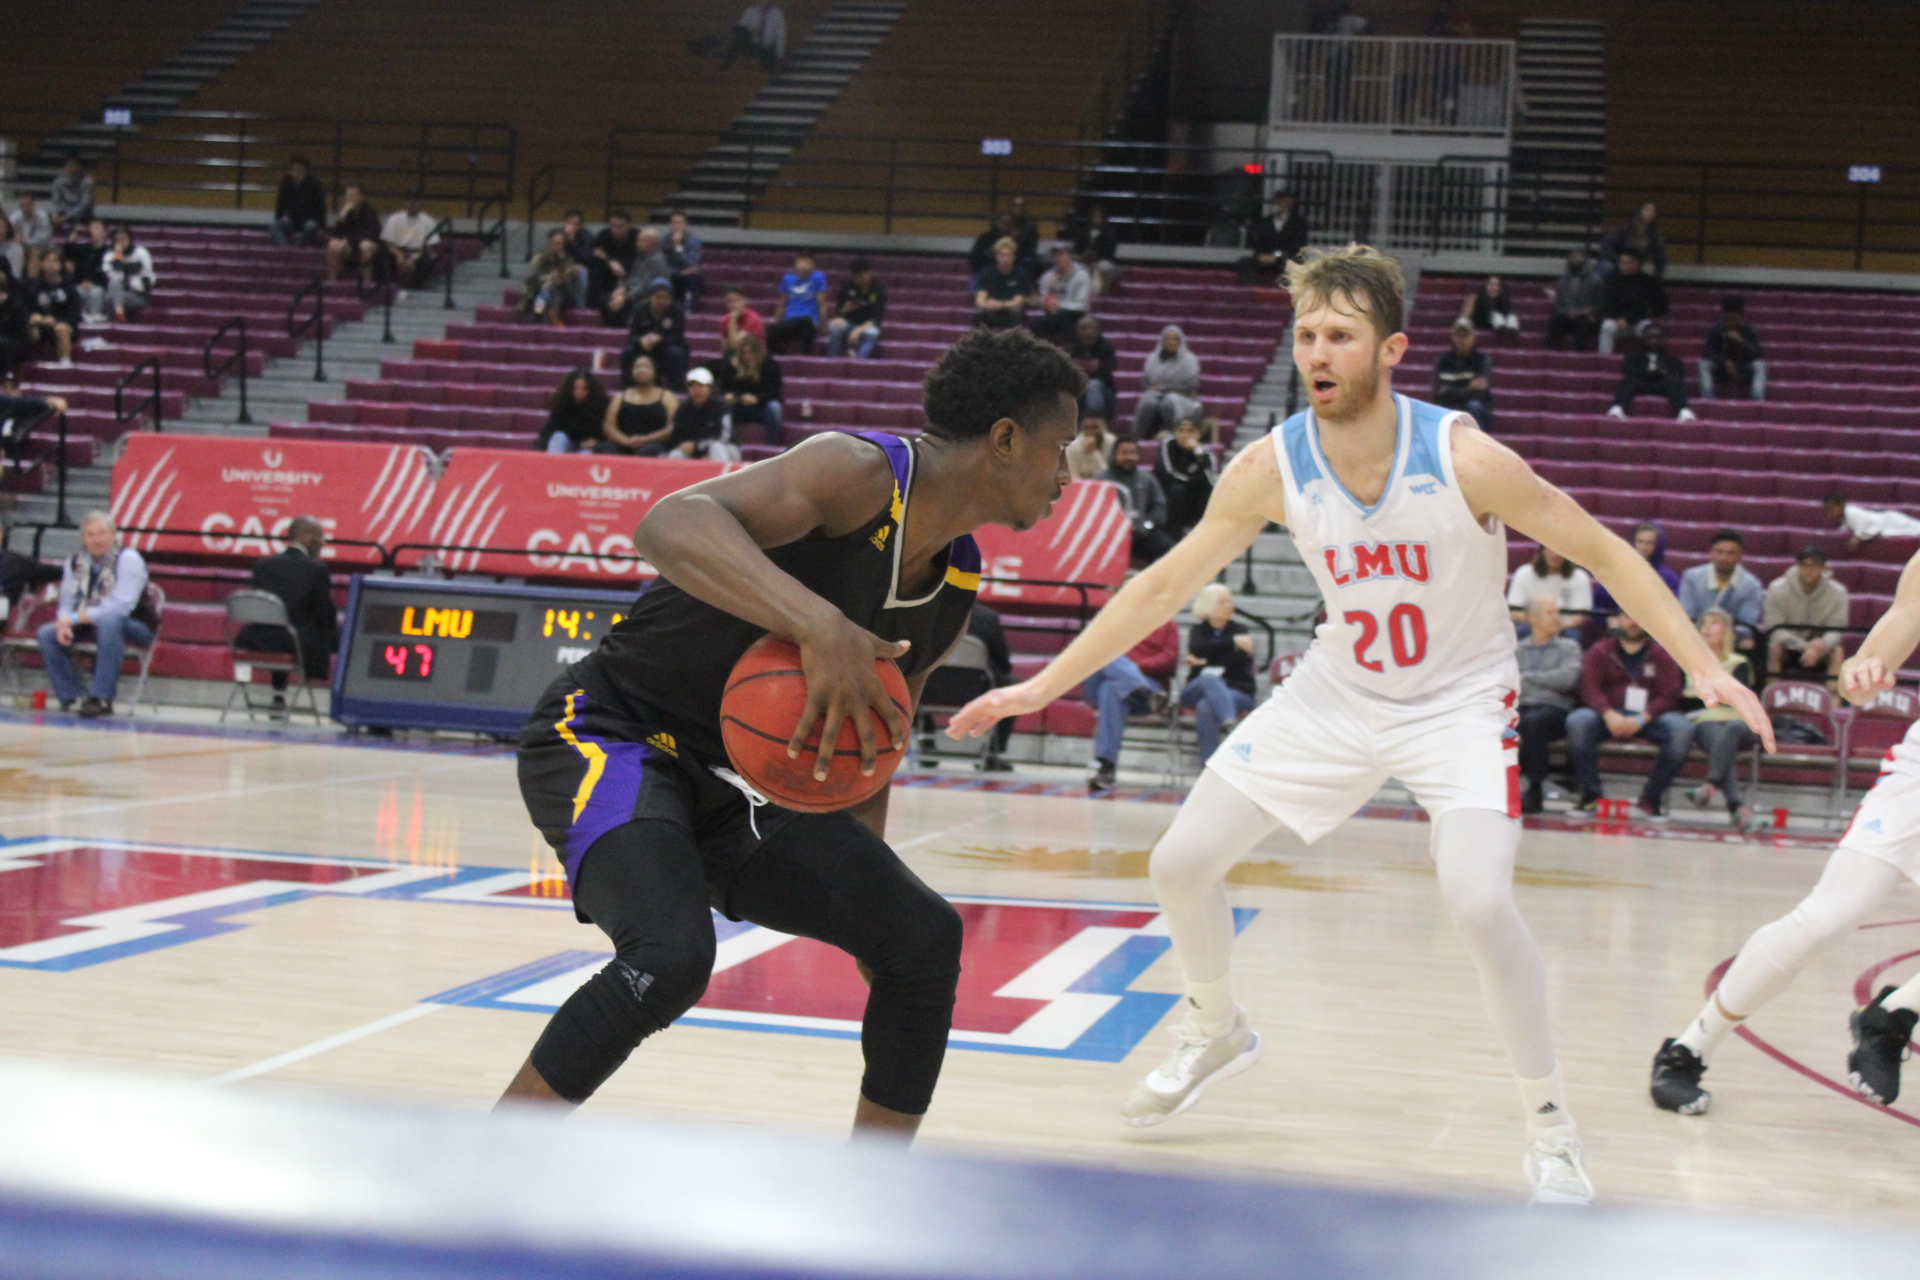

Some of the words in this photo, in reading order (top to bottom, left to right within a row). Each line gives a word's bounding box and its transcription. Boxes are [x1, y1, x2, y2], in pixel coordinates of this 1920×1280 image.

[221, 468, 324, 486] UNIVERSITY
[546, 482, 653, 502] UNIVERSITY
[1323, 541, 1433, 587] LMU
[401, 606, 475, 639] LMU
[1342, 602, 1429, 673] 20
[384, 644, 433, 677] 47
[1773, 686, 1822, 712] LMU
